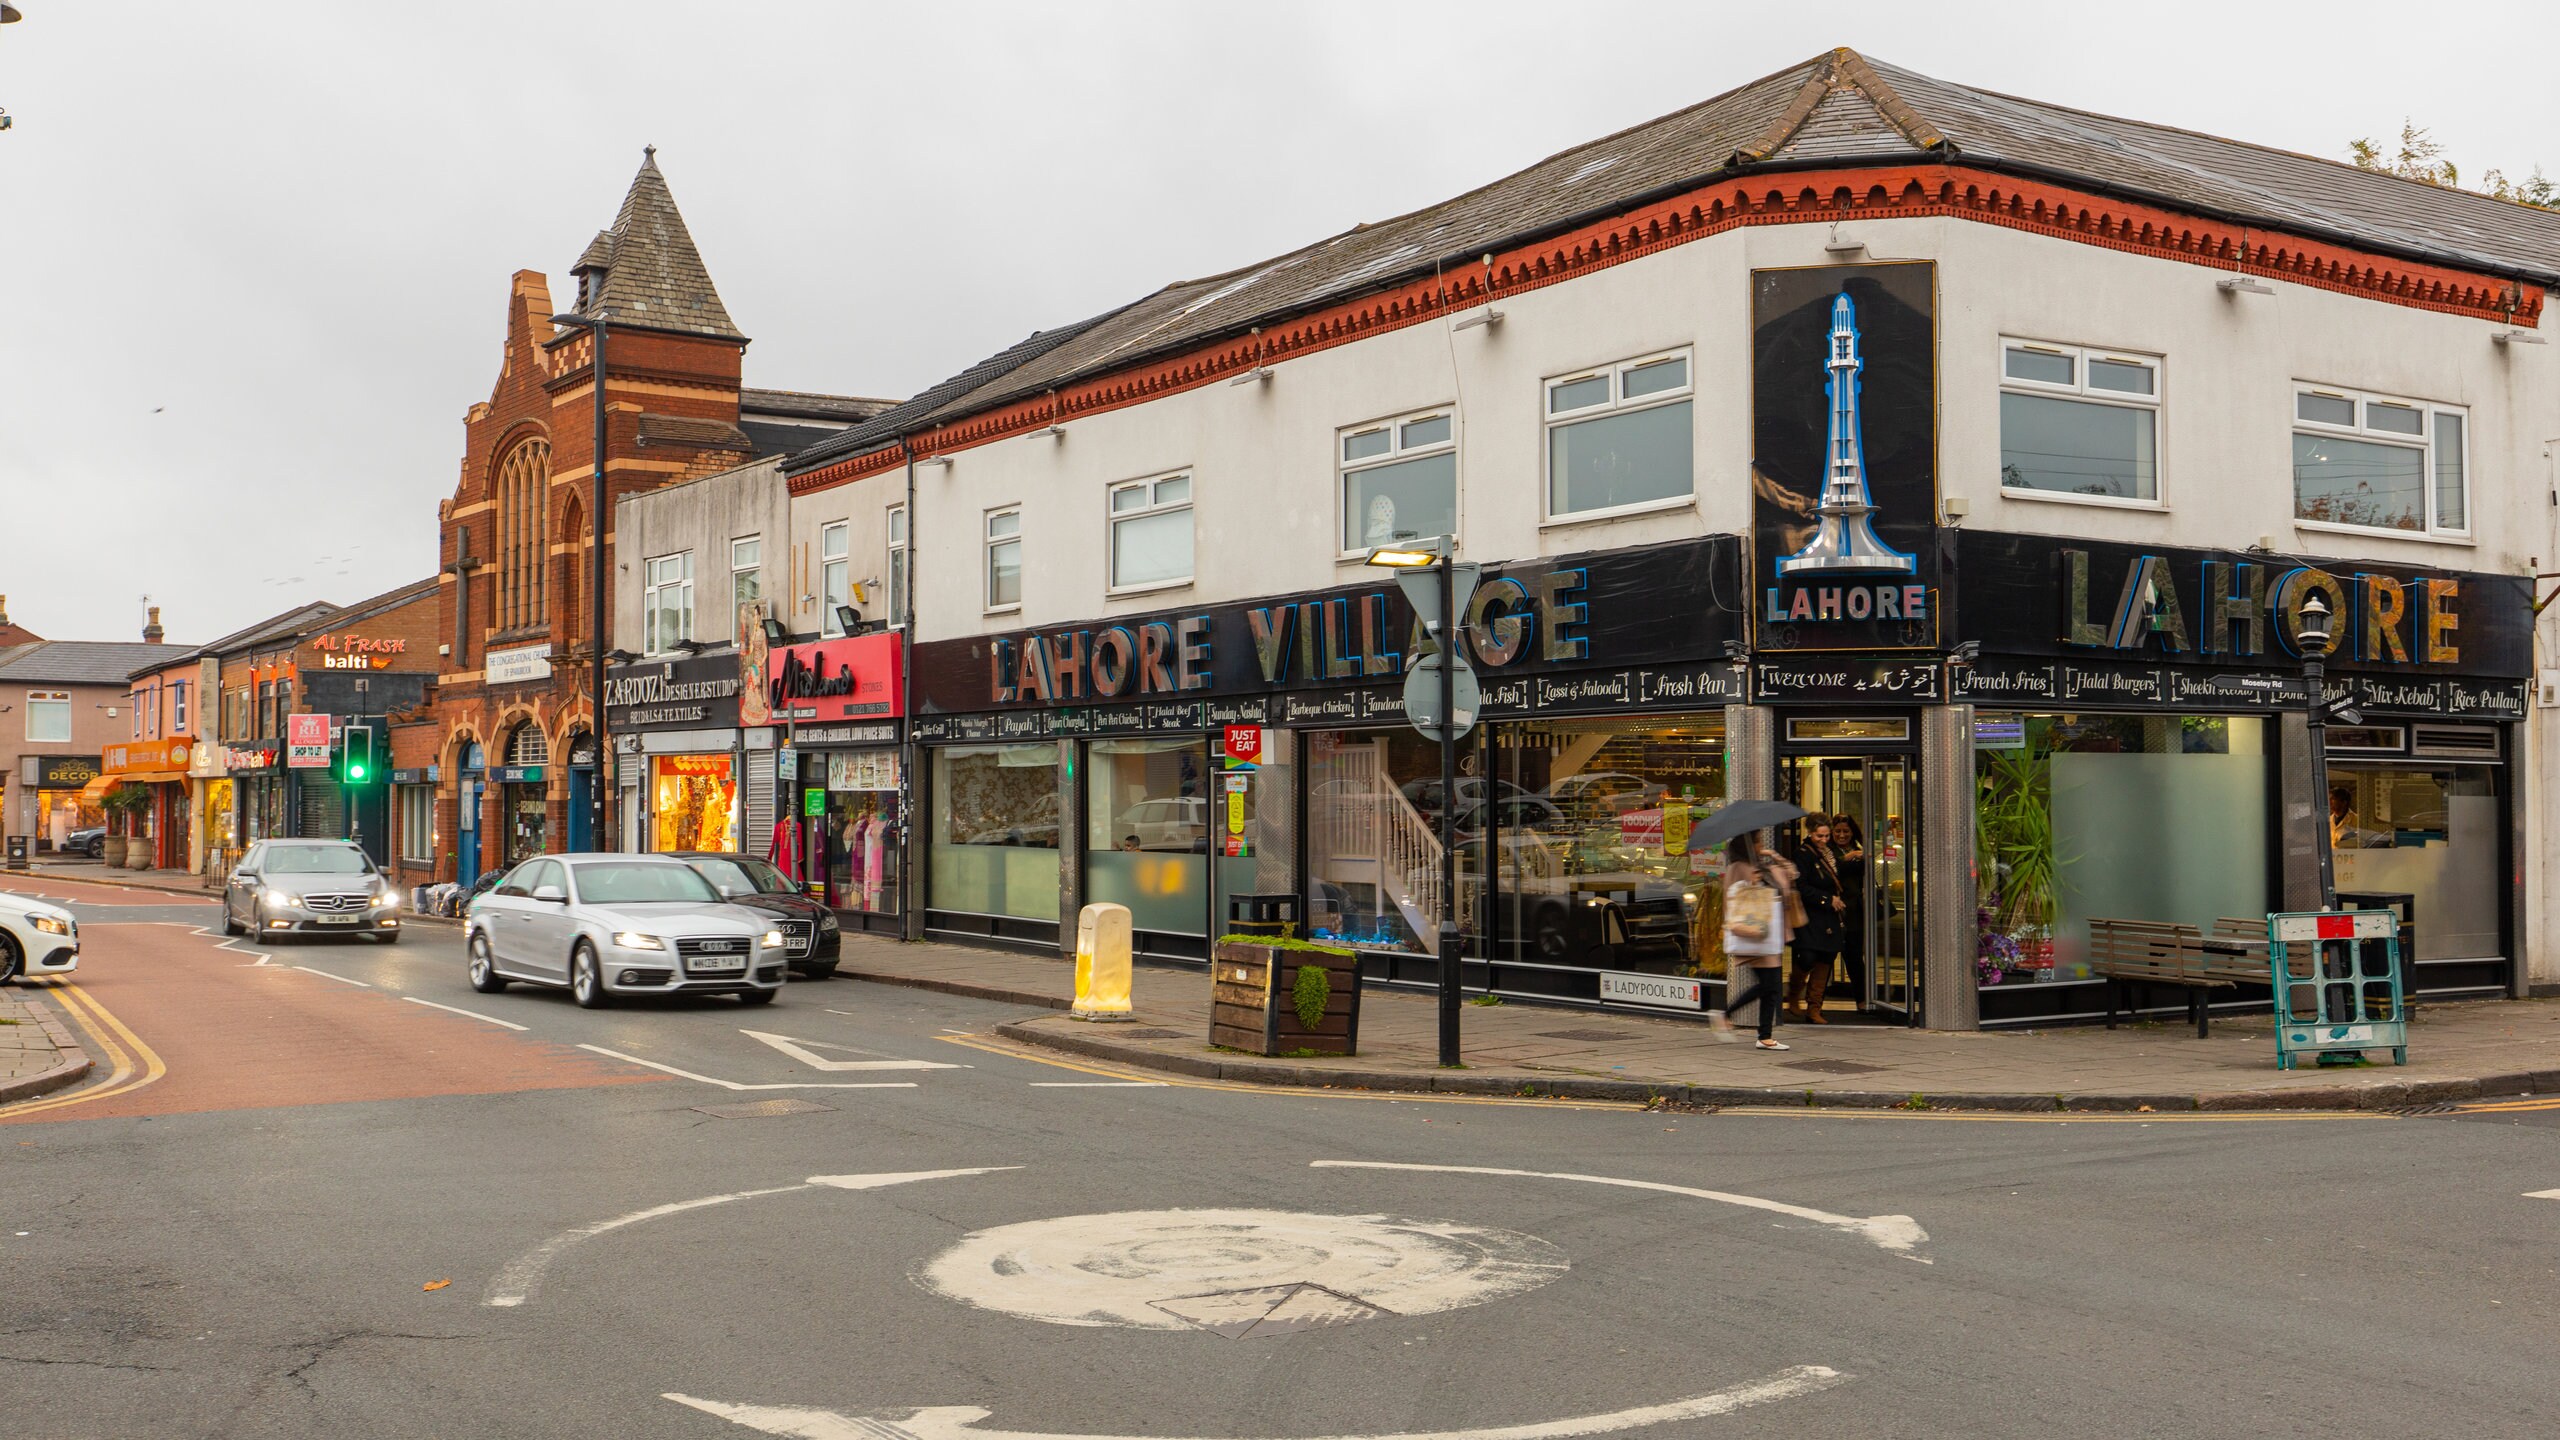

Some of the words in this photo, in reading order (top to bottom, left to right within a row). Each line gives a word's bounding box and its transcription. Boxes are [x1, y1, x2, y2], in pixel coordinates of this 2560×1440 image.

[1767, 585, 1926, 623] LAHORE
[2054, 547, 2459, 665] LAHORE
[313, 634, 339, 651] AL
[344, 634, 406, 653] FRASH
[991, 615, 1211, 703] LAHORE
[1247, 567, 1590, 683] VILLGE
[324, 653, 368, 669] balti
[1653, 673, 1693, 696] Fresh
[1697, 672, 1726, 695] Pan
[1768, 672, 1847, 689] WELCOME
[1962, 669, 2010, 690] French
[2012, 669, 2047, 691] Fries
[2072, 672, 2109, 693] Halal
[2112, 672, 2156, 696] Burgers
[2241, 679, 2271, 689] Moseley
[2272, 680, 2283, 688] Rd
[605, 675, 664, 707] ZARDOZI
[1494, 686, 1519, 704] Fish
[1544, 682, 1568, 701] Lassi
[1579, 679, 1622, 696] Falooda
[2370, 681, 2393, 704] Mix
[2393, 683, 2434, 707] Kebab
[1368, 696, 1404, 712] Tandoori
[2453, 689, 2479, 708] Rice
[2480, 690, 2518, 710] Pullau
[1118, 712, 1139, 725] Chicken
[1152, 706, 1175, 719] Halal
[1176, 704, 1191, 718] Beef
[1211, 705, 1237, 724] Sunday
[1237, 702, 1263, 720] Nashta
[1291, 703, 1322, 718] Barbeque
[1322, 701, 1351, 714] Chicken
[299, 725, 320, 735] RH
[1005, 717, 1033, 737] Payah
[1162, 718, 1181, 728] Steak
[1230, 730, 1256, 742] JUST
[1236, 741, 1256, 751] EAT
[48, 771, 99, 780] DECOR
[1623, 815, 1661, 827] FOODHUB
[1642, 835, 1662, 844] ONLINE
[1614, 980, 1666, 998] LADYPOOL
